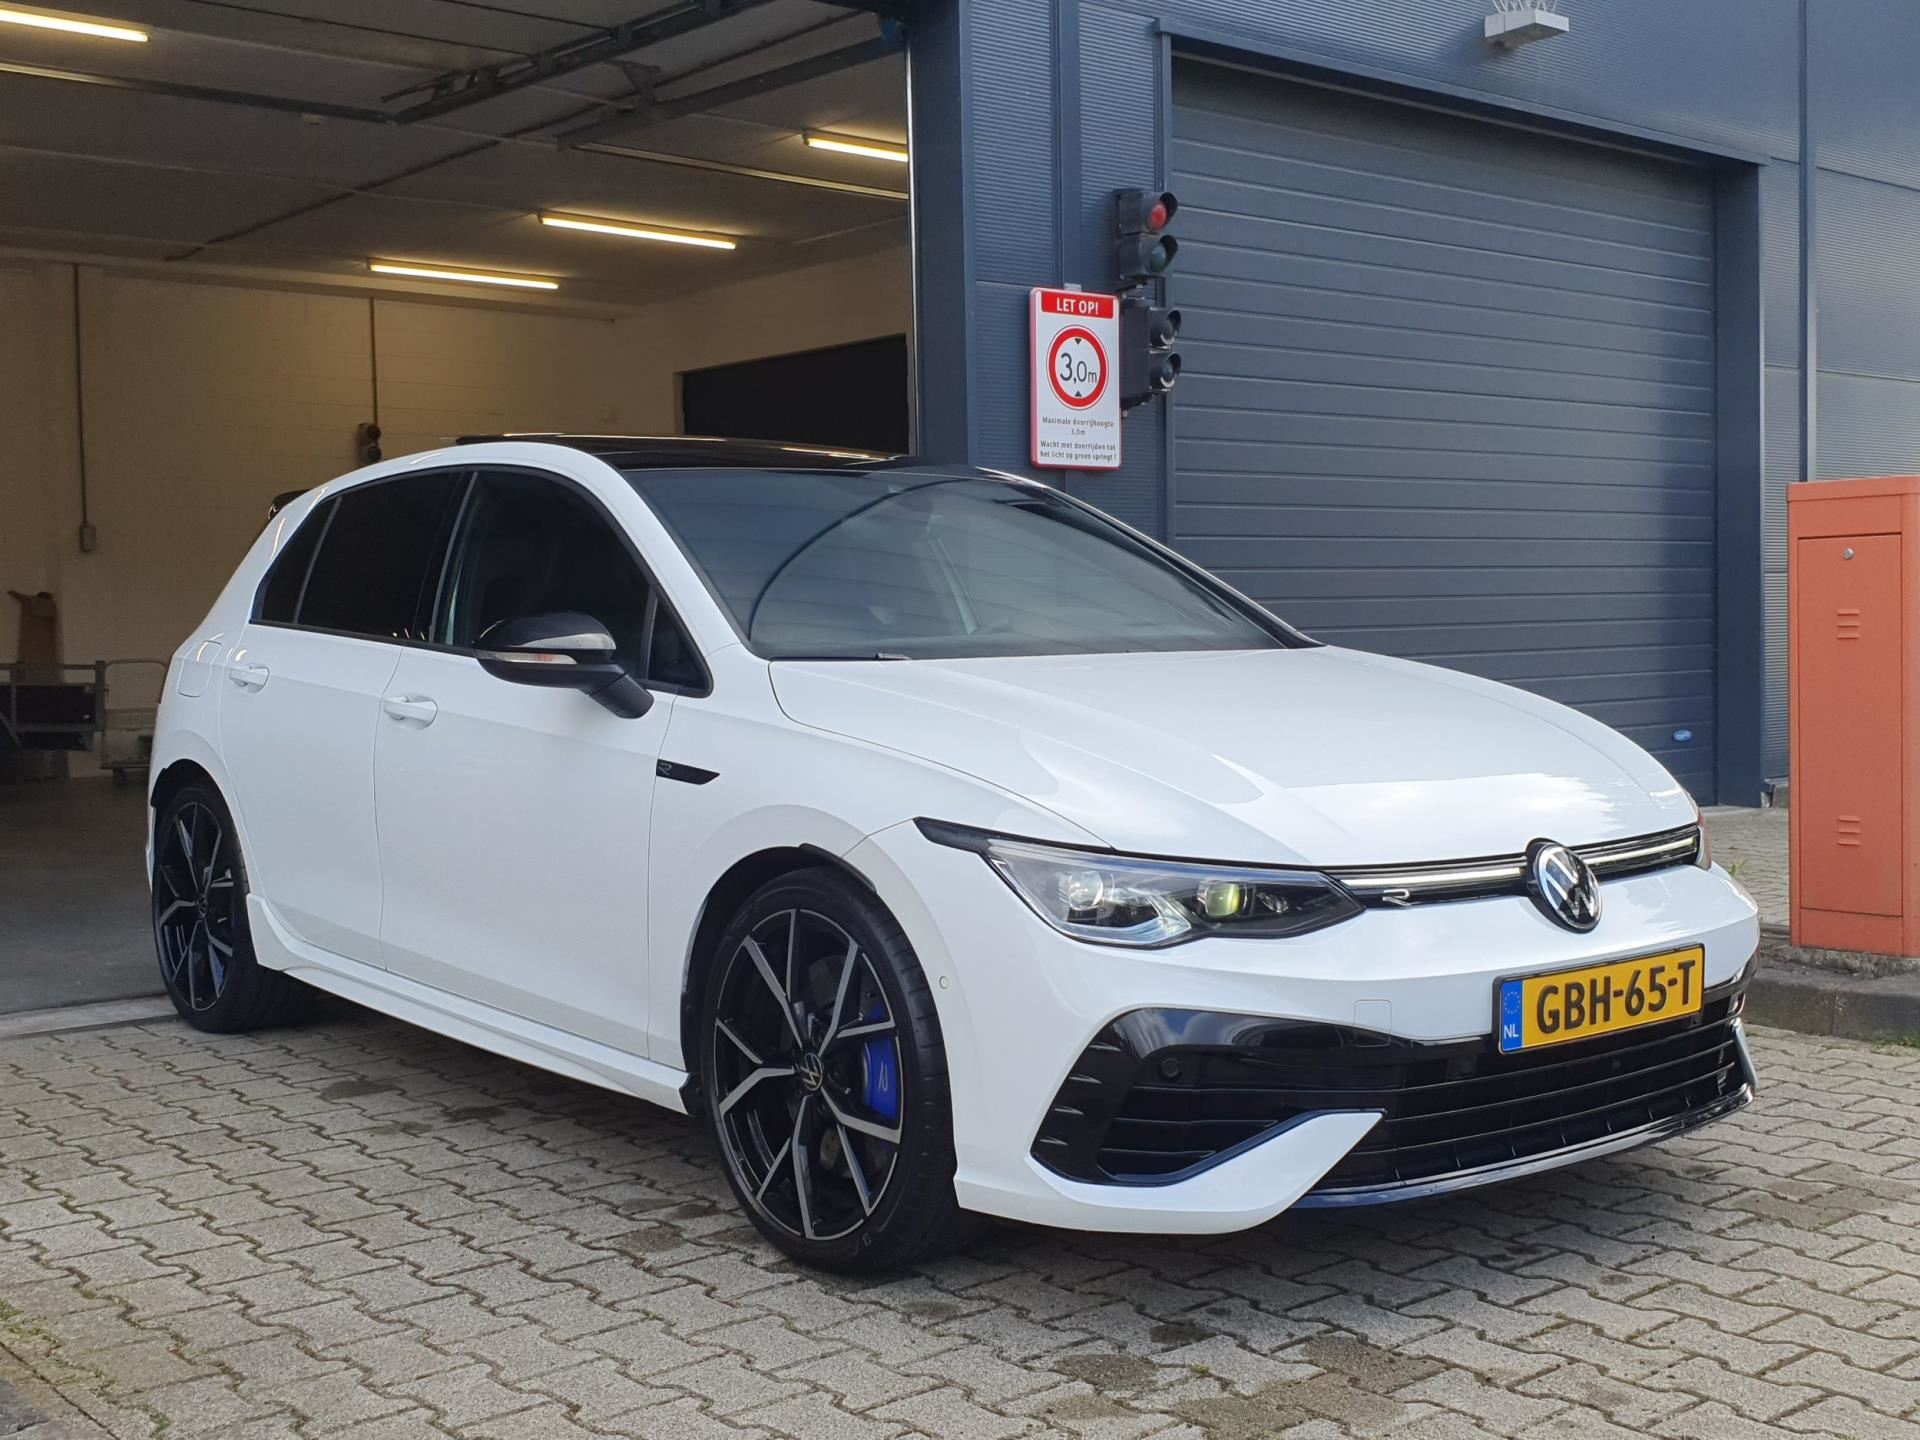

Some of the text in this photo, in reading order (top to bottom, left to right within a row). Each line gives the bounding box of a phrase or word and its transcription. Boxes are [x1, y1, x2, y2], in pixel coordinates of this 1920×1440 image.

[1056, 297, 1099, 315] LET OP!
[1042, 416, 1114, 428] Maximale doorrijhoogte
[1040, 440, 1060, 448] Wacht
[1074, 442, 1105, 451] doorrijden
[1040, 450, 1050, 458] het
[1536, 959, 1696, 1034] GBH-65-T
[1503, 1023, 1520, 1039] NL
